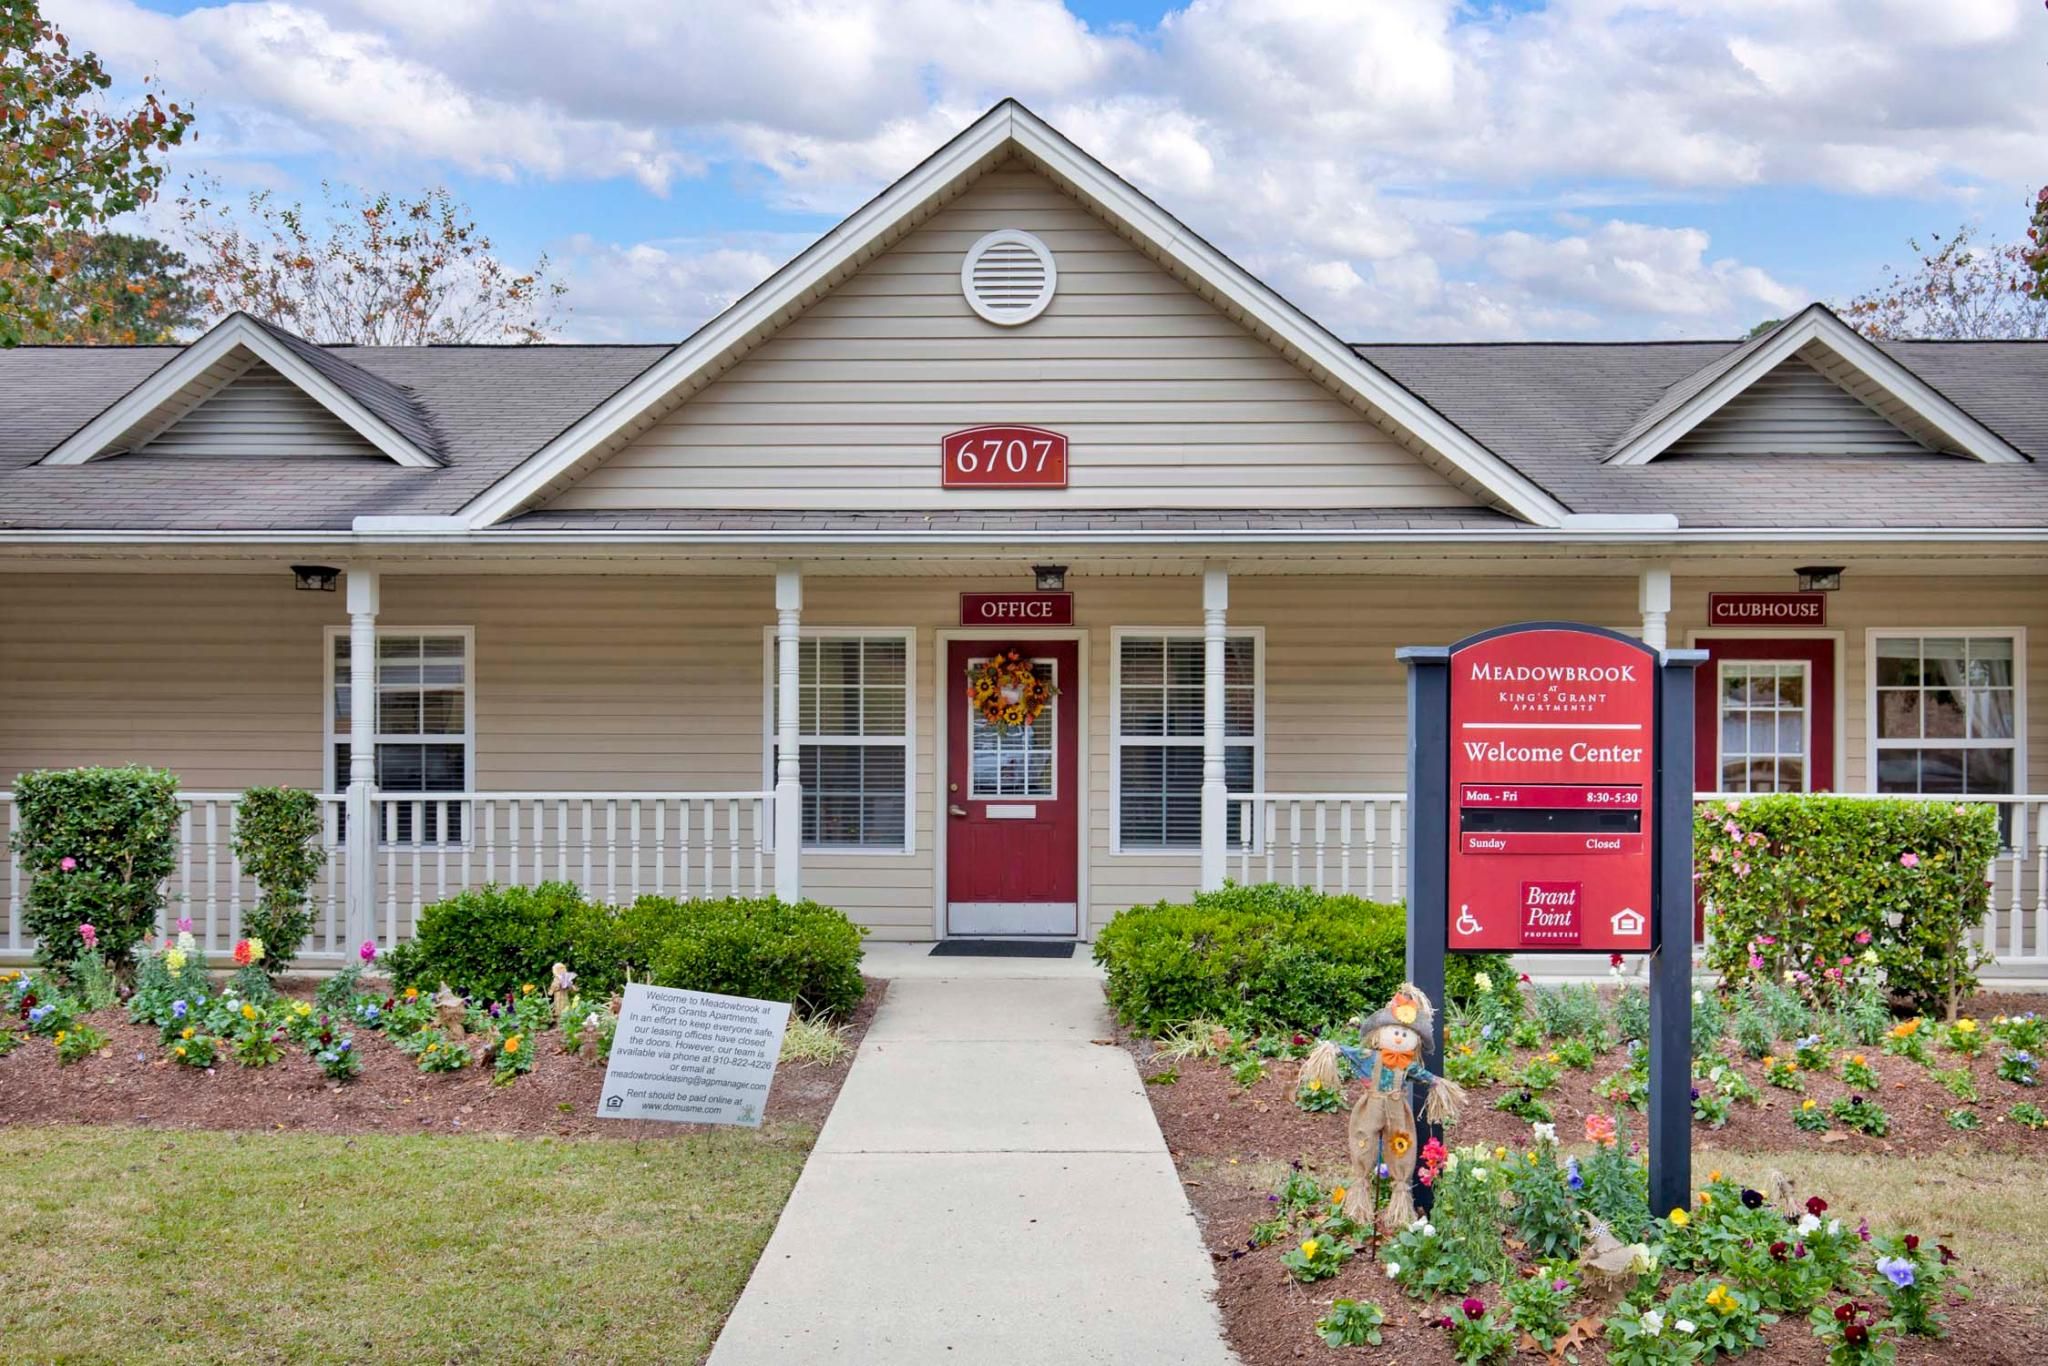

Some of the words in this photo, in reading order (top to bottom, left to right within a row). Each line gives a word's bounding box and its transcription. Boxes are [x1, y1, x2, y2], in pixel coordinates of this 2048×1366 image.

[956, 440, 1053, 472] 6707
[981, 601, 1053, 617] OFFICE
[1716, 603, 1819, 617] CLUBHOUSE
[1470, 662, 1636, 682] MEADOWBROOK
[1499, 692, 1549, 702] KING'S
[1558, 692, 1607, 703] GRANT
[1463, 741, 1563, 763] Welcome
[1569, 742, 1643, 763] Center
[1466, 790, 1492, 801] Mon.
[1503, 791, 1518, 801] Fri
[1586, 792, 1638, 803] 8:30-5:30
[1469, 838, 1506, 850] Sunday
[1586, 838, 1621, 849] Closed
[1526, 886, 1576, 905] Brant
[1527, 907, 1572, 926] Point
[646, 991, 687, 1004] Welcome
[690, 996, 698, 1005] to
[700, 998, 760, 1014] Meadowbrook
[762, 1007, 771, 1015] at
[651, 1003, 676, 1015] Kings
[679, 1006, 707, 1018] Grants
[709, 1010, 760, 1025] Apartments.
[630, 1012, 639, 1021] In
[654, 1015, 677, 1026] effort
[679, 1019, 688, 1027] to
[689, 1020, 711, 1031] keep
[713, 1023, 753, 1034] everyone
[755, 1028, 775, 1038] safe,
[634, 1025, 650, 1033] our
[651, 1026, 683, 1039] leasing
[684, 1030, 713, 1041] offices
[714, 1033, 736, 1043] have
[738, 1036, 767, 1047] closed
[629, 1036, 644, 1044] the
[645, 1038, 672, 1048] doors.
[675, 1040, 715, 1053] However,
[717, 1046, 732, 1054] our
[734, 1047, 756, 1057] team
[616, 1047, 656, 1058] available
[658, 1051, 671, 1059] via
[672, 1052, 700, 1062] phone
[701, 1055, 711, 1063] at
[712, 1055, 773, 1070] 910-822-4226
[670, 1063, 680, 1071] or
[681, 1064, 705, 1073] email
[706, 1067, 716, 1075] at
[610, 1070, 767, 1091] meadowbrookleasing@agpmanager.com
[626, 1088, 647, 1098] Rent
[648, 1090, 675, 1100] should
[676, 1092, 687, 1101] be
[688, 1094, 707, 1103] paid
[708, 1095, 733, 1105] online
[733, 1098, 743, 1106] at
[641, 1102, 722, 1114] www.domusme.com
